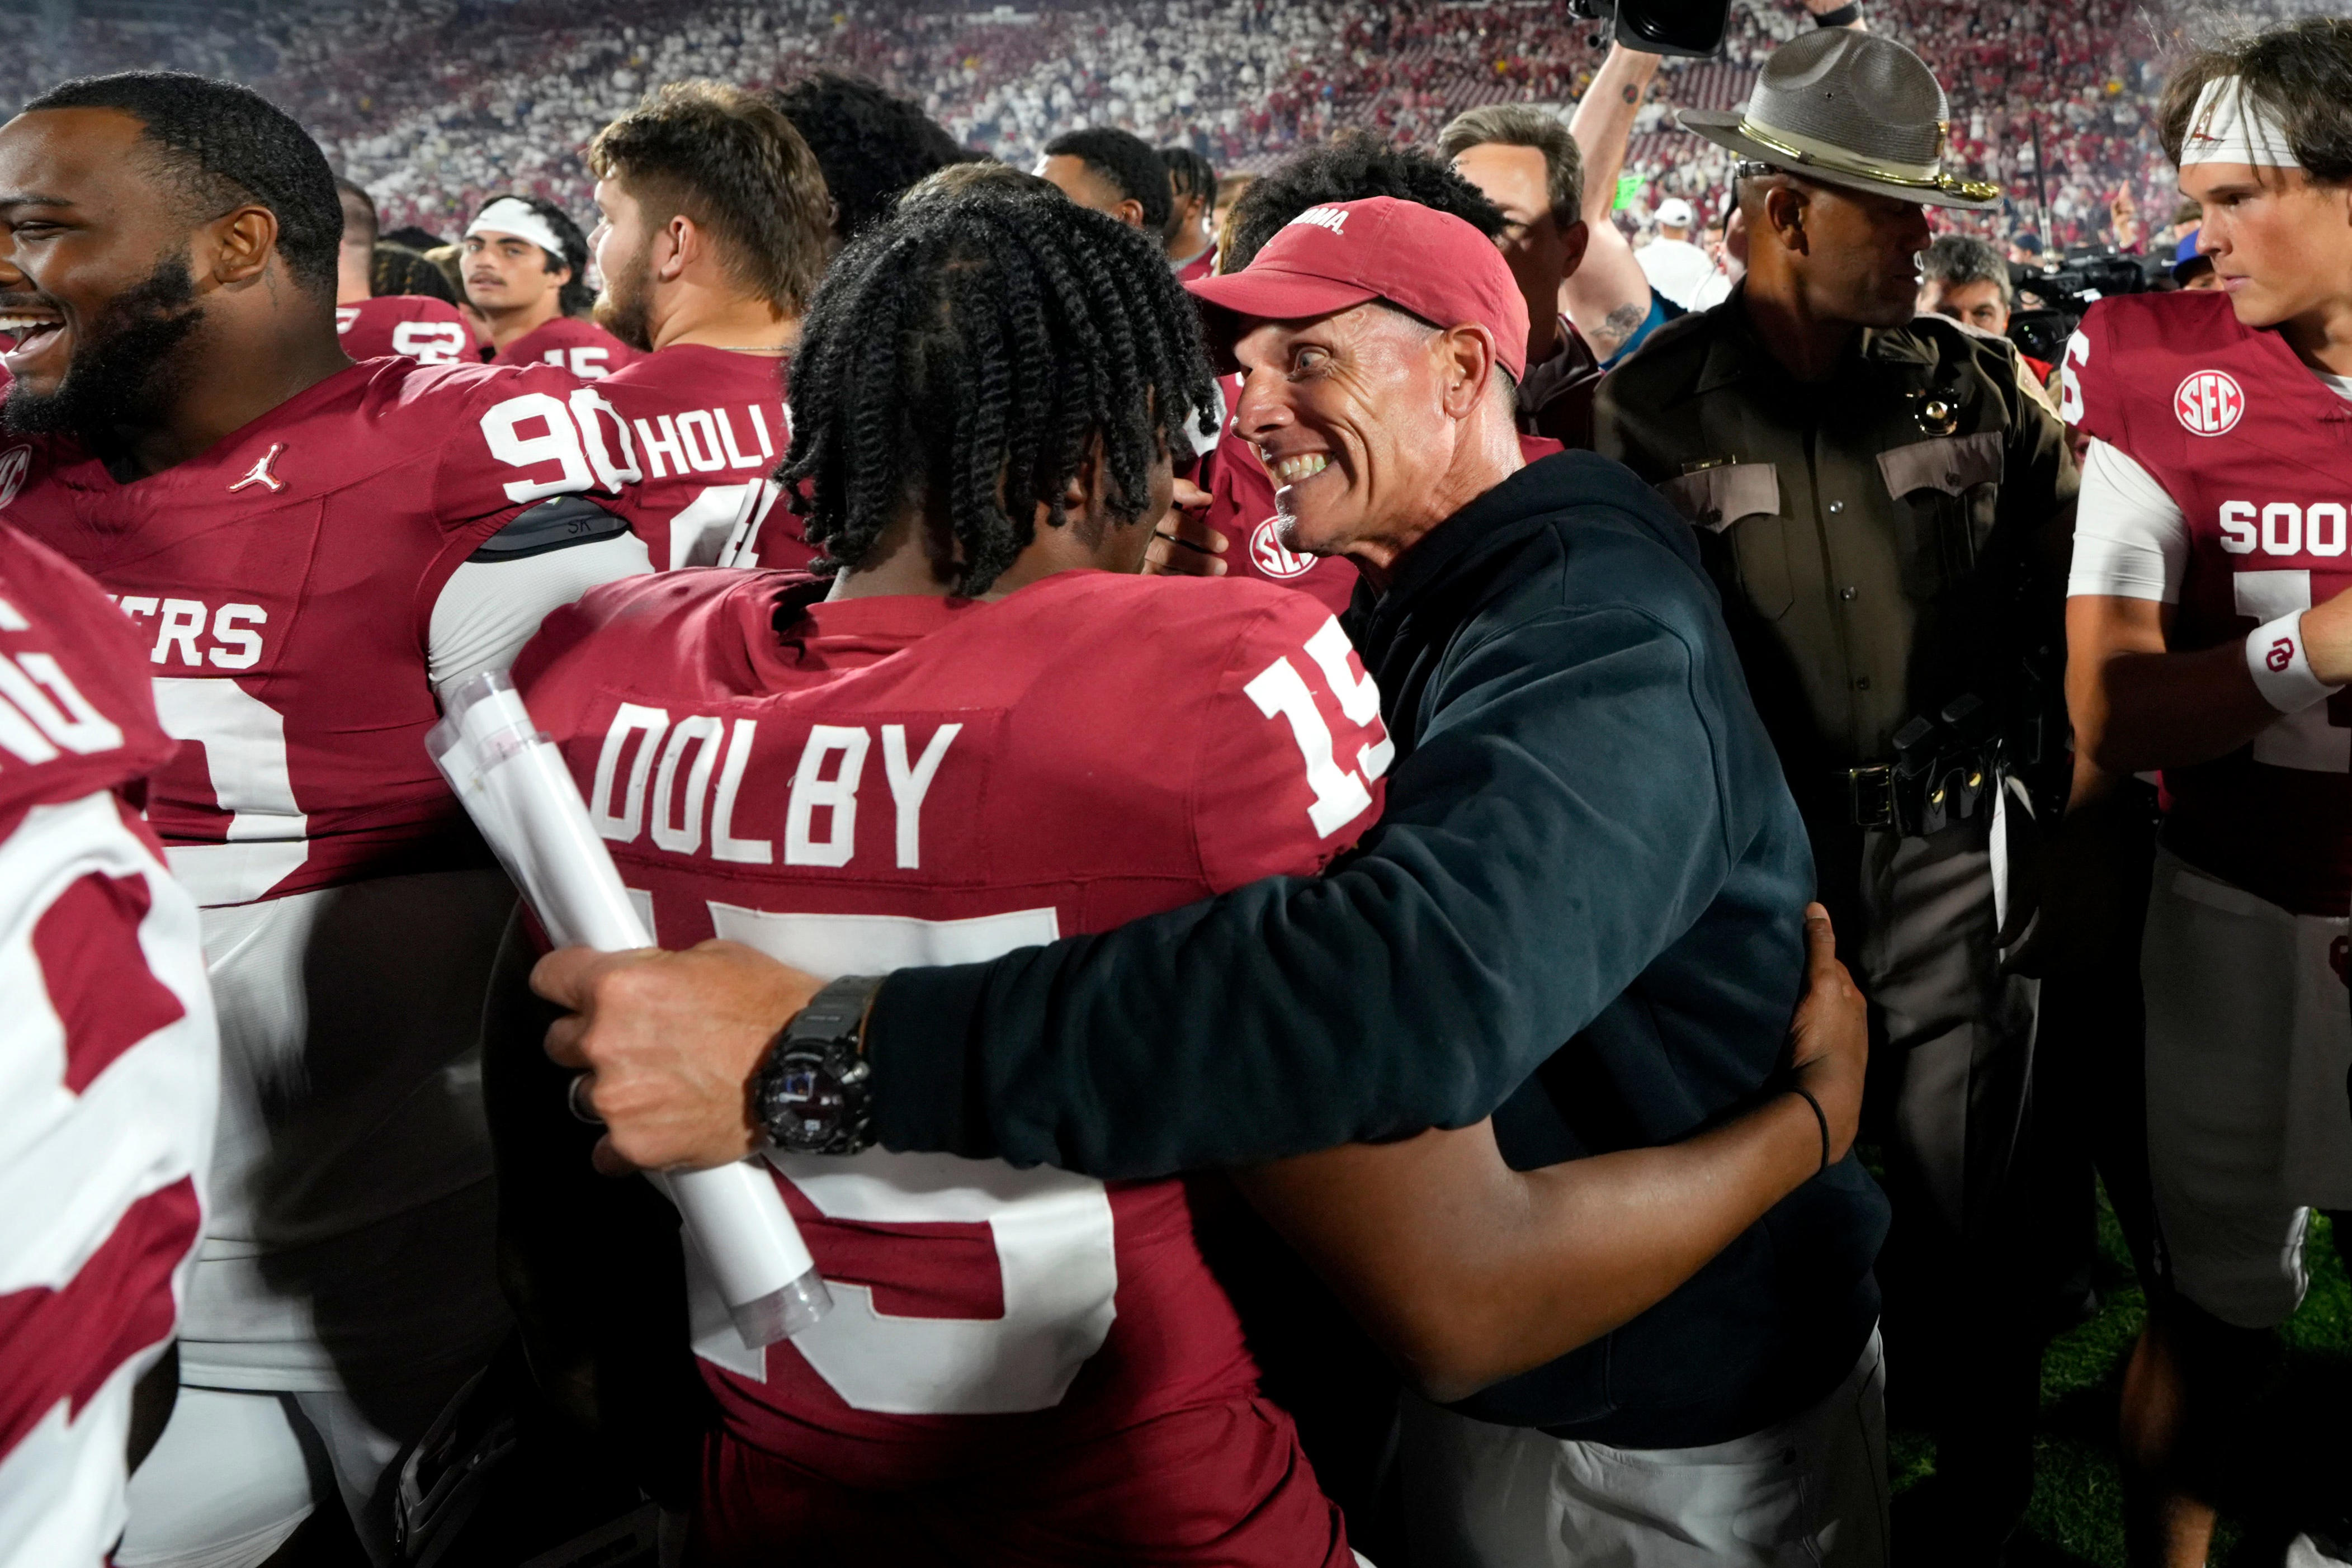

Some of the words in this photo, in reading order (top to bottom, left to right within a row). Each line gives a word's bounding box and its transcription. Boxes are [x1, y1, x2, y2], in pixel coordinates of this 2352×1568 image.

[480, 389, 643, 503] 90
[2180, 375, 2237, 432] SEC
[2219, 500, 2352, 556] SOO
[106, 594, 268, 669] ERS
[1243, 613, 1395, 839] 15
[591, 702, 963, 869] DOLBY
[625, 888, 1117, 1415] 5
